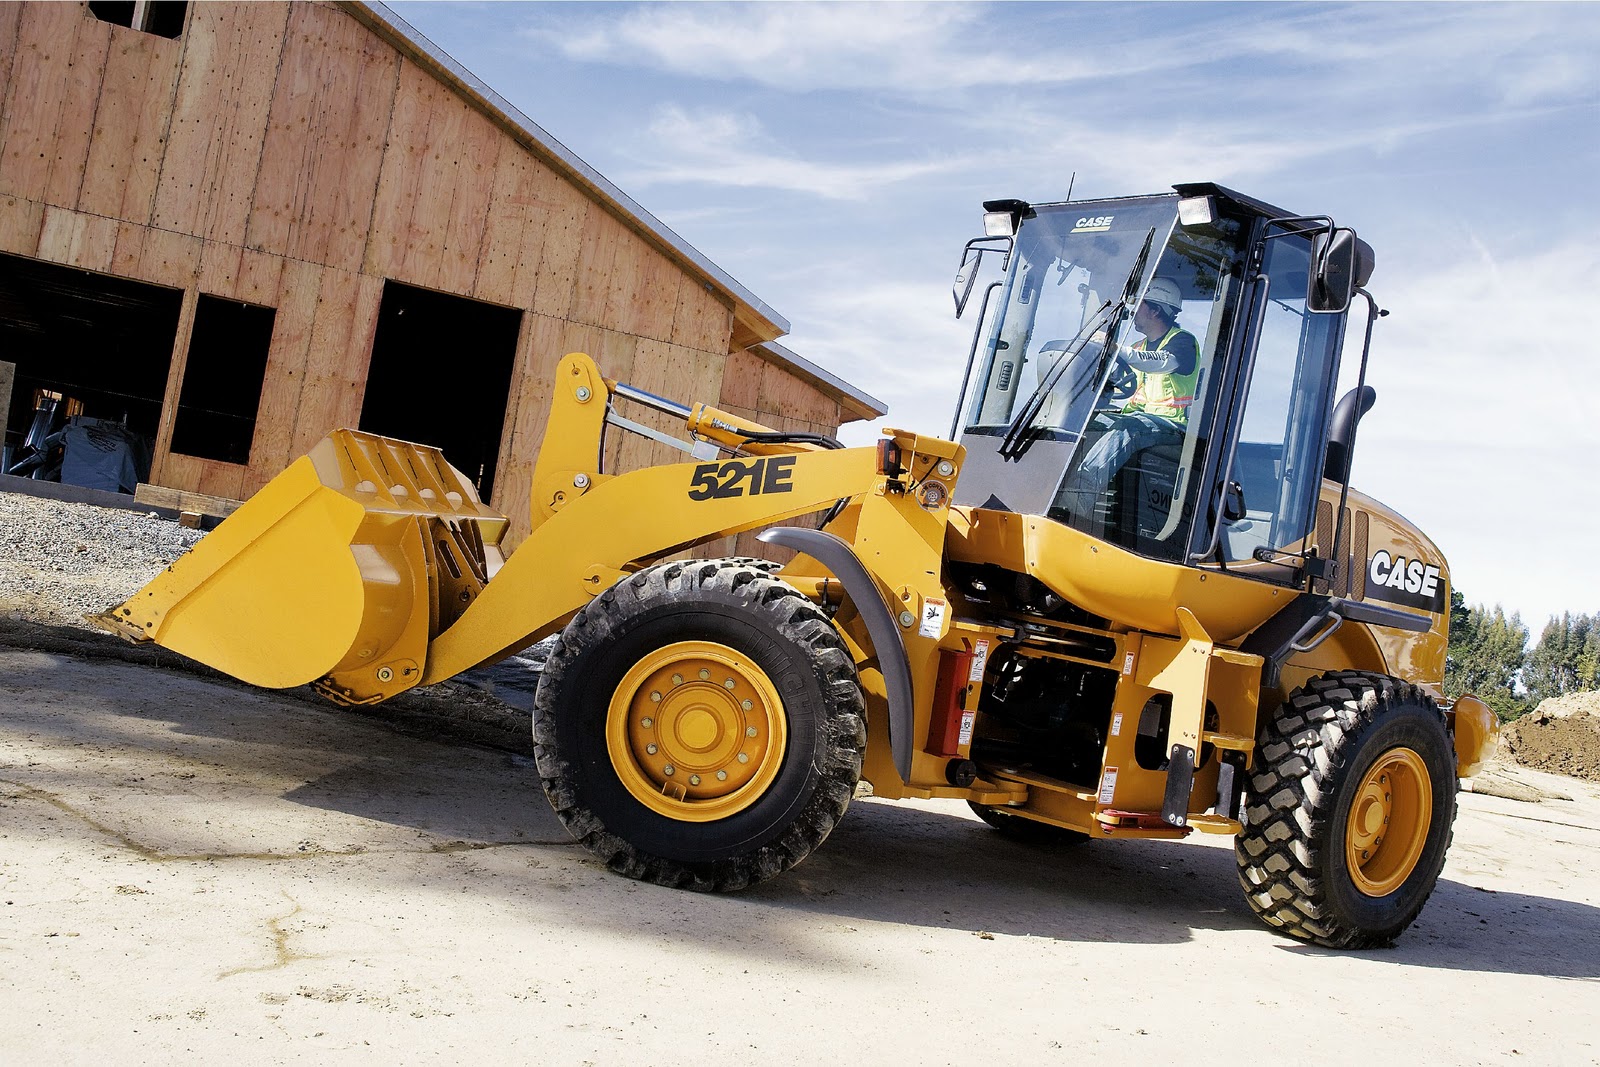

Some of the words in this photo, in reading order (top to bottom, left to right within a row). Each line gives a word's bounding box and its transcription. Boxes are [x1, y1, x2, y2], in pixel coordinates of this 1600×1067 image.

[1075, 216, 1114, 227] CASE
[688, 456, 797, 501] 521E
[1370, 552, 1440, 598] CASE
